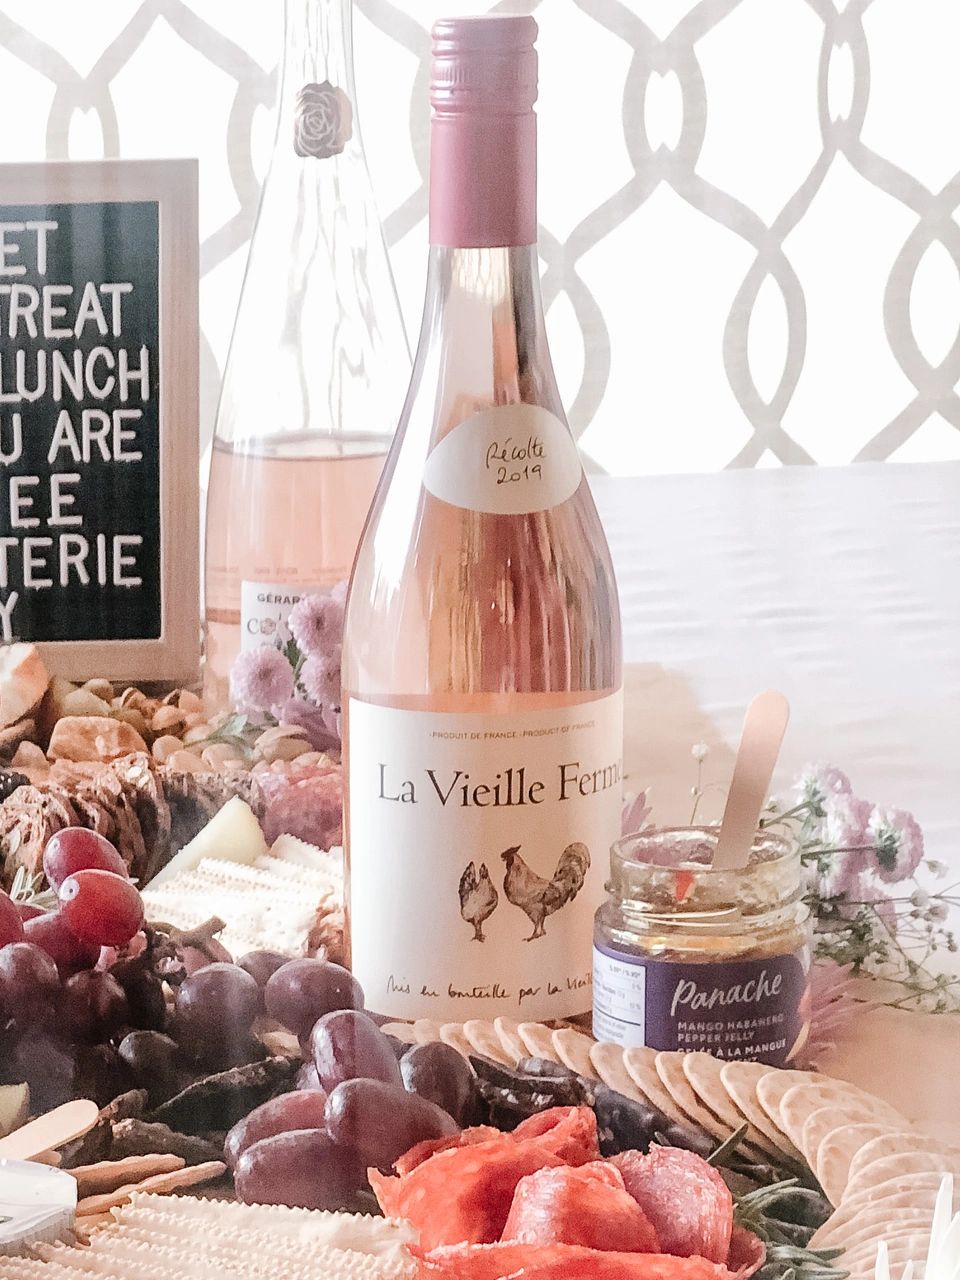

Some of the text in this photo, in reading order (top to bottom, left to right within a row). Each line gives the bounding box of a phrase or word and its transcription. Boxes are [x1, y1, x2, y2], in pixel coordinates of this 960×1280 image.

[47, 408, 143, 464] ARE
[486, 436, 547, 469] Récolte
[496, 464, 542, 485] 2019
[257, 592, 305, 605] GÉRAR
[471, 732, 480, 741] DE
[484, 731, 516, 740] FRANCE
[522, 727, 559, 738] PRODUCT
[561, 726, 570, 734] OF
[378, 762, 419, 804] La
[424, 767, 545, 807] Vieille
[547, 982, 562, 995] la
[670, 969, 782, 1017] Panache
[677, 1013, 784, 1032] MANGO HABANERO
[677, 1030, 755, 1043] PEPPER JELLY
[727, 1047, 742, 1057] LA
